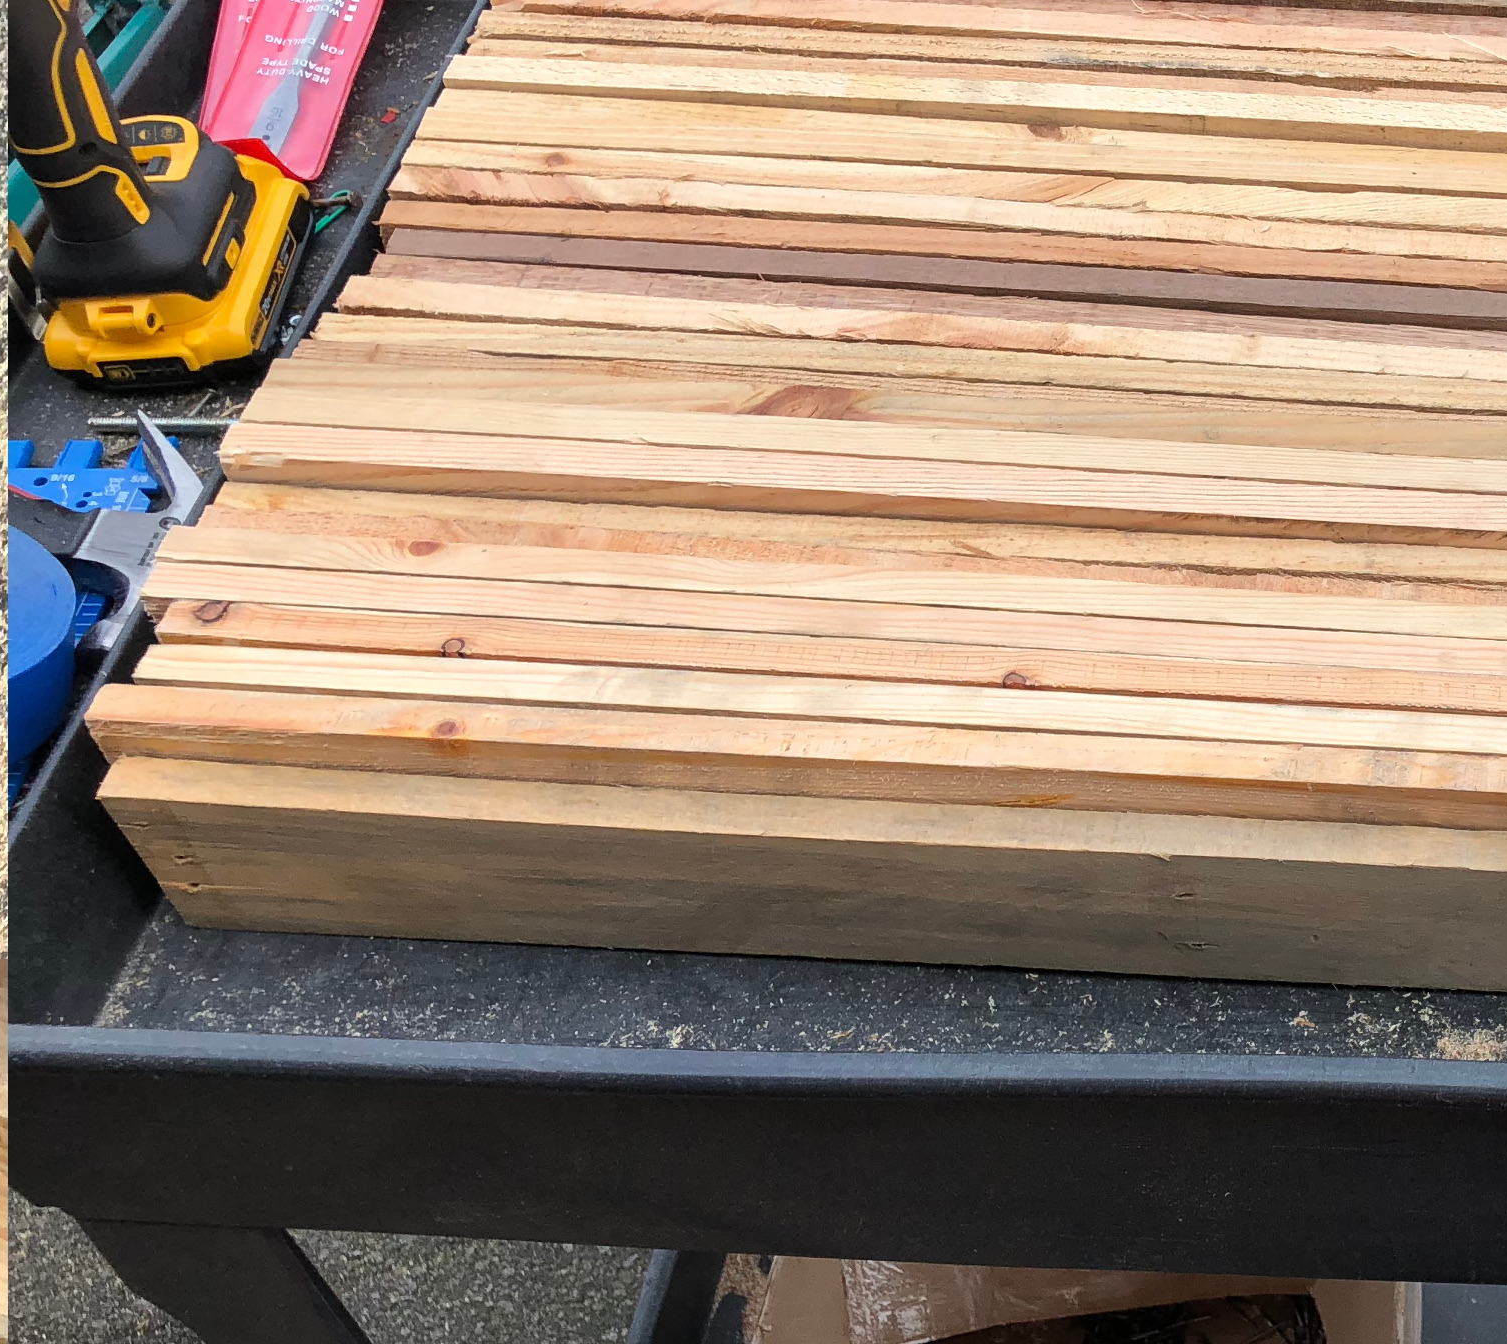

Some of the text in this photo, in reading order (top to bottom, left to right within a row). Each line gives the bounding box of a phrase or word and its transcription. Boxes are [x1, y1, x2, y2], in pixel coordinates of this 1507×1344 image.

[306, 5, 340, 18] WOOD
[264, 34, 345, 56] FOR DRILLING
[262, 57, 332, 76] SPADE TYPE
[256, 67, 330, 85] HEAVY-DUTY
[50, 473, 76, 483] 9/16
